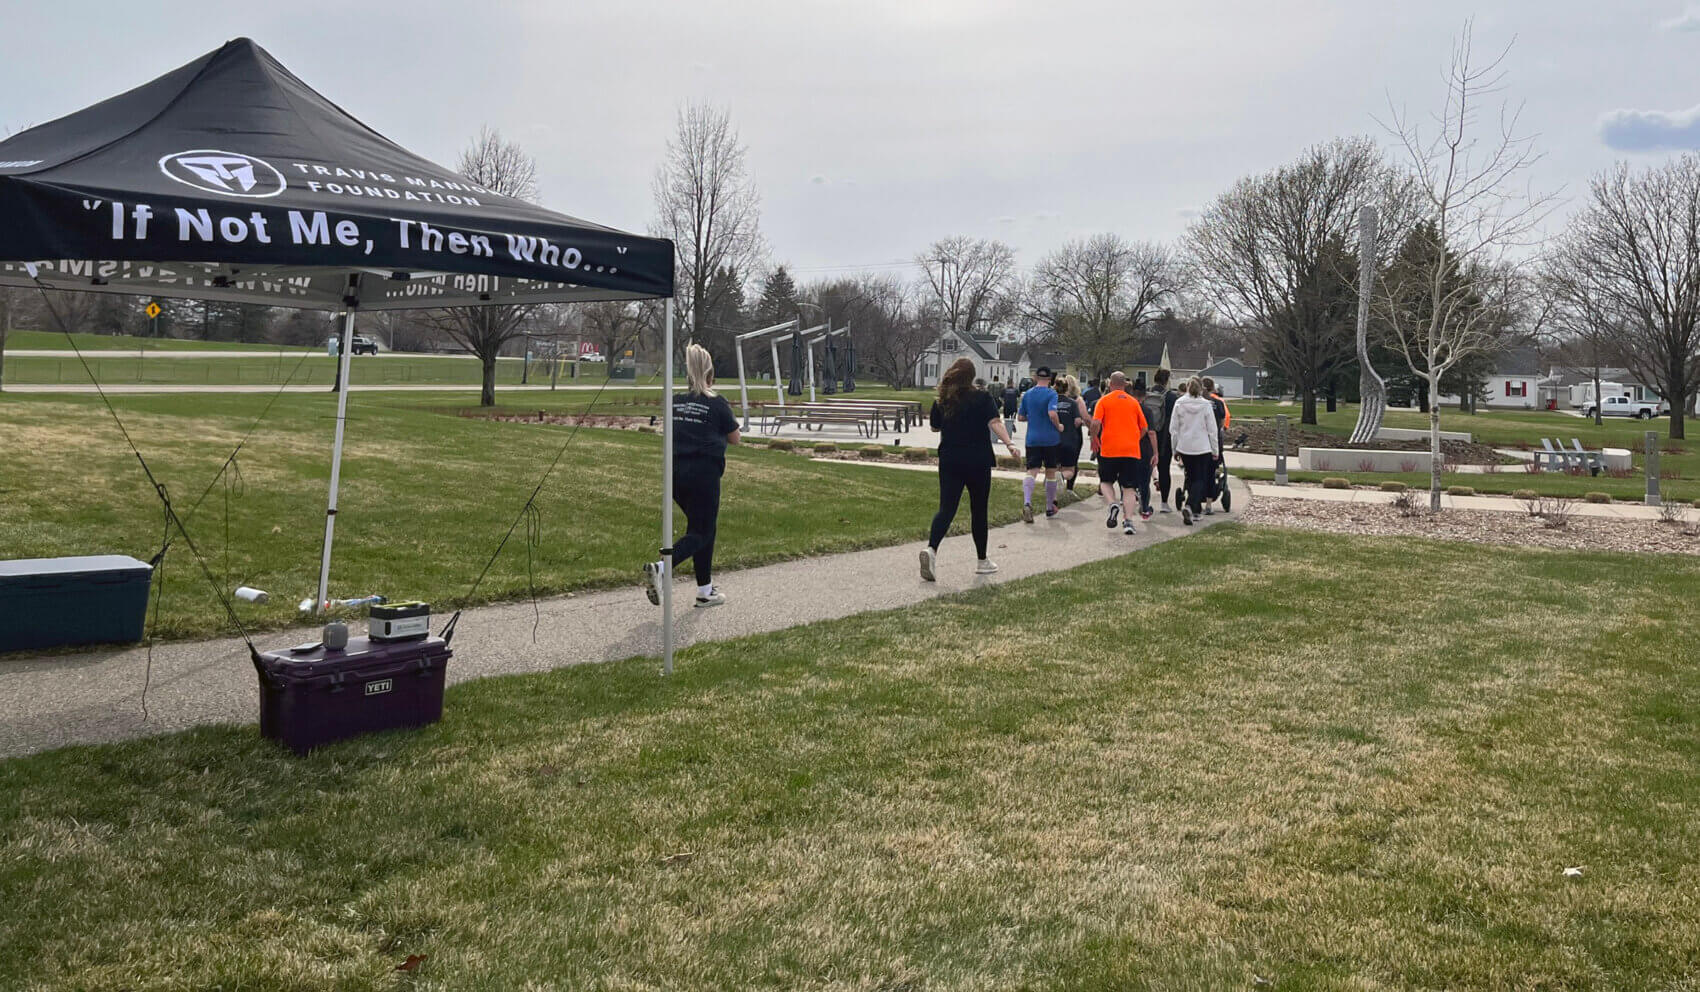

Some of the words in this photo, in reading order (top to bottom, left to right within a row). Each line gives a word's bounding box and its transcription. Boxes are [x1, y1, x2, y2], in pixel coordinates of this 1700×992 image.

[292, 163, 397, 183] TRAVIS
[306, 180, 481, 207] FOUNDATION
[174, 207, 272, 244] Not
[287, 210, 375, 255] Me,
[389, 217, 494, 258] Then
[367, 681, 390, 693] YETI
